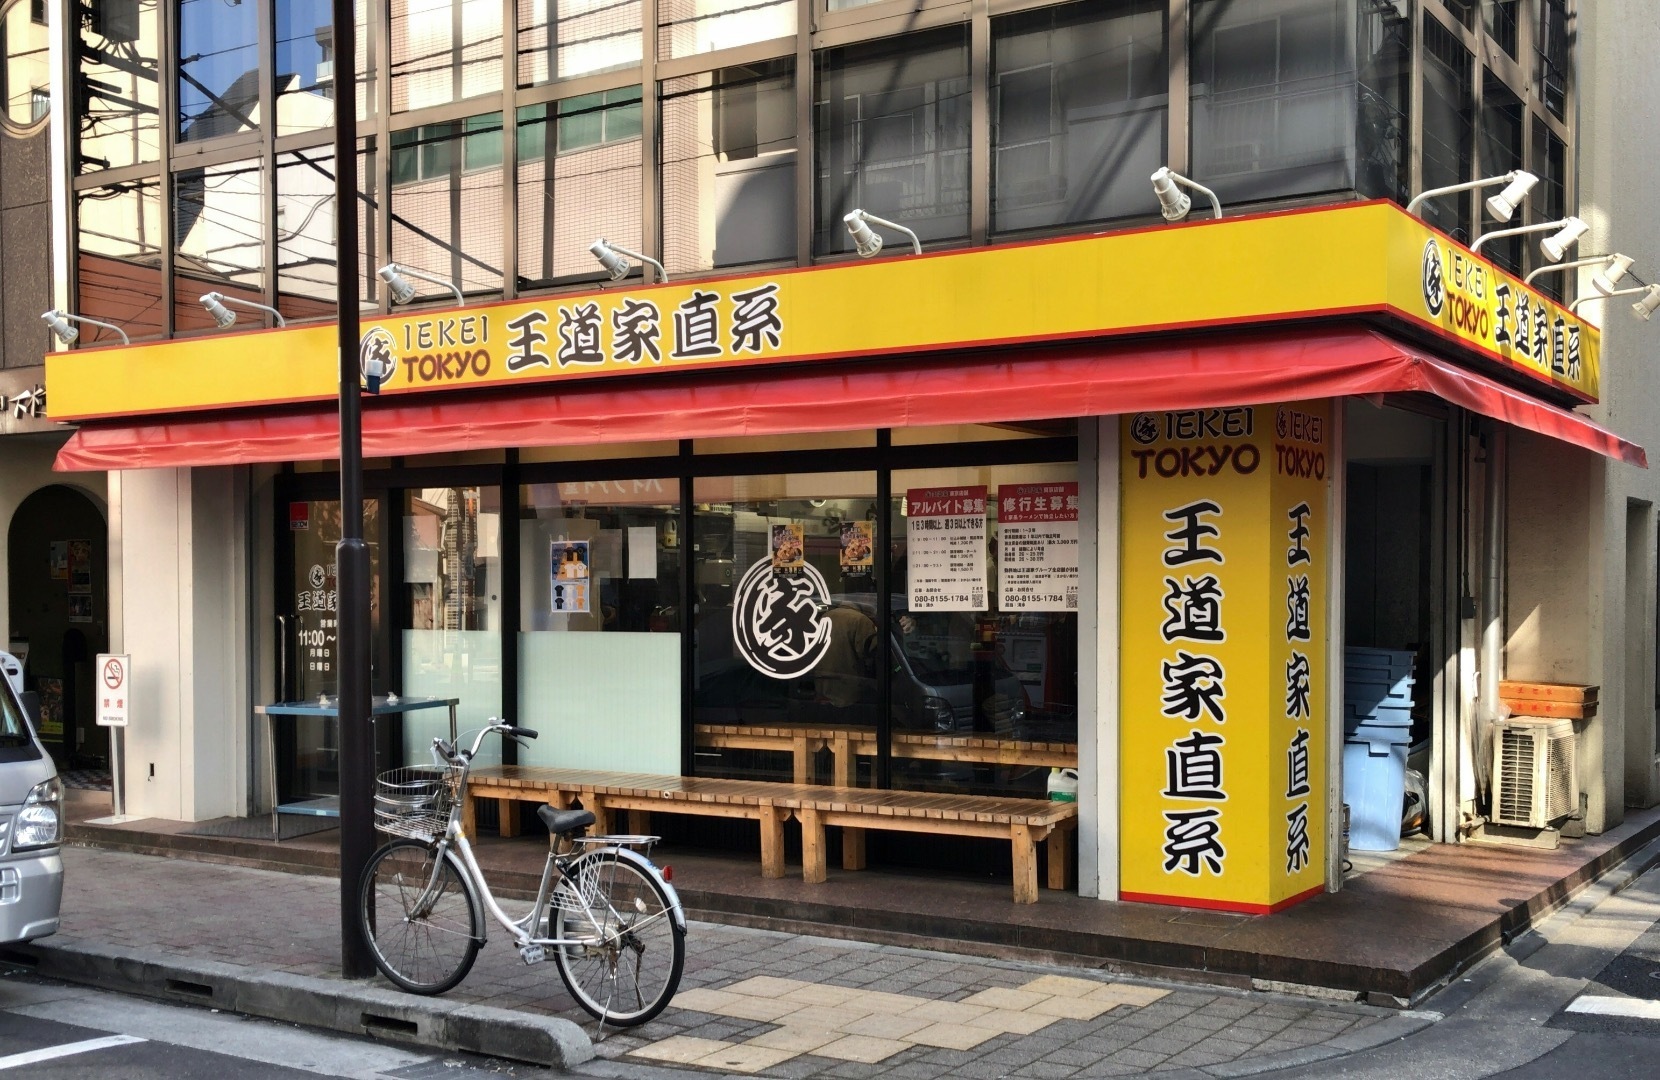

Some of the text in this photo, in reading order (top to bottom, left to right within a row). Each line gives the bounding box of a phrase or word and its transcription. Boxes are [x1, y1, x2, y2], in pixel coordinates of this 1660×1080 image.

[1448, 249, 1488, 300] IEKEI
[404, 315, 488, 351] IEKEI
[505, 282, 783, 373] 王道家直系
[1447, 291, 1489, 340] TOKYO
[1495, 282, 1581, 381] 王道家直系
[402, 349, 491, 383] TOKYO
[1164, 407, 1254, 440] IEKEI
[1288, 410, 1324, 445] IEKEI
[1131, 443, 1261, 479] TOKYO
[1275, 443, 1325, 481] TOKYO
[911, 498, 984, 515] アルバイト募集
[1003, 495, 1078, 513] 修行生募集
[914, 595, 969, 603] 080-8155-1784
[1160, 498, 1229, 876] 王道家直系
[1286, 500, 1312, 877] 王道家直系
